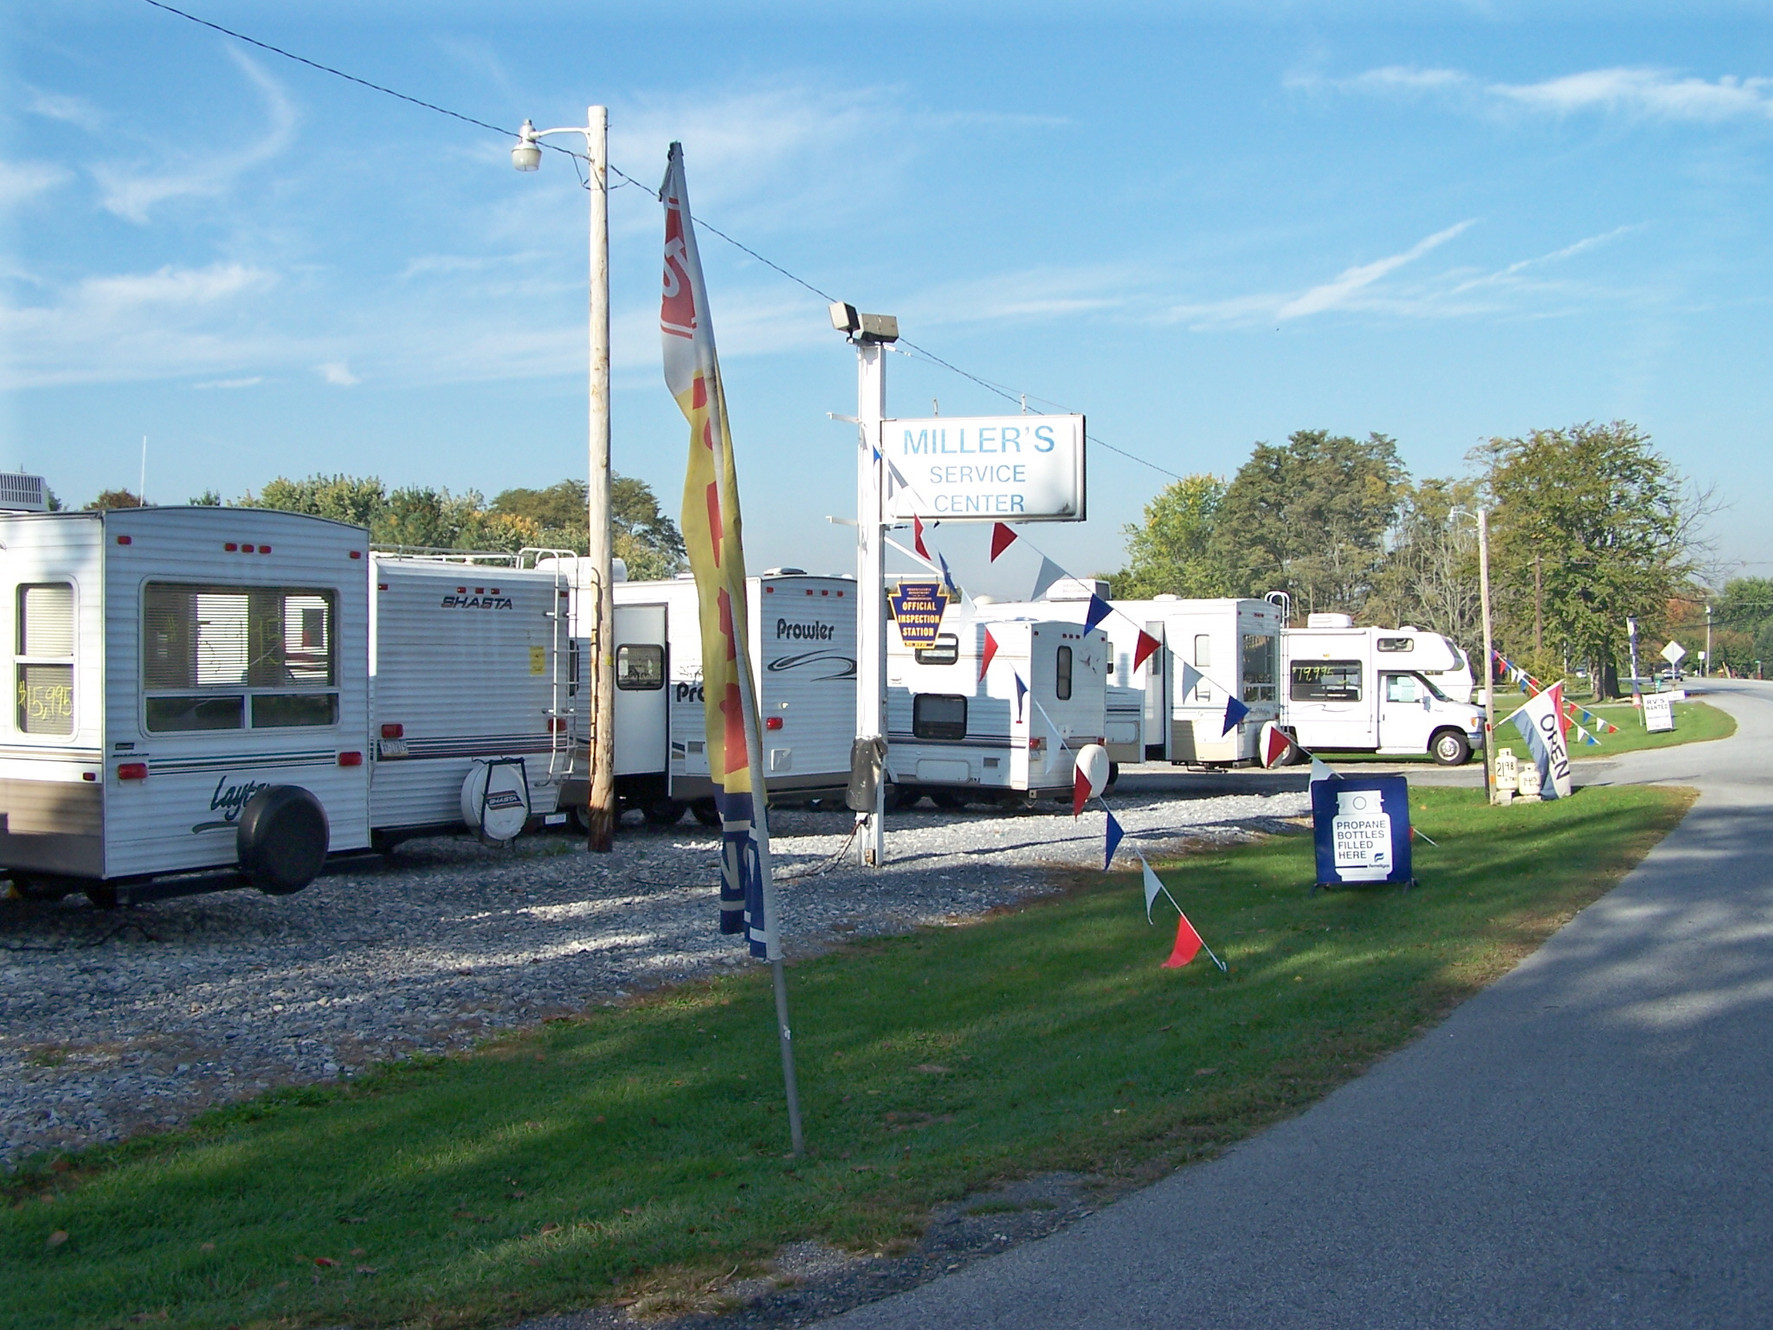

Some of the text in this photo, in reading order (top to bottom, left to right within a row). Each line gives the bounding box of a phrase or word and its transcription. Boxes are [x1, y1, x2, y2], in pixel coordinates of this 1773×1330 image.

[904, 425, 1055, 455] MILLER'S
[930, 464, 1026, 483] SERVICE
[934, 494, 1025, 512] CENTER
[441, 596, 513, 609] SHASTA
[902, 601, 936, 611] OFFICIAL
[898, 614, 940, 624] INSPECTION
[776, 618, 834, 641] Prowler
[902, 627, 934, 637] STATION
[1540, 713, 1571, 780] OPEN
[1336, 820, 1386, 829] PROPANE
[1337, 830, 1385, 840] BOTTLES
[1338, 841, 1374, 849] FILLED
[1338, 851, 1367, 859] HERE
